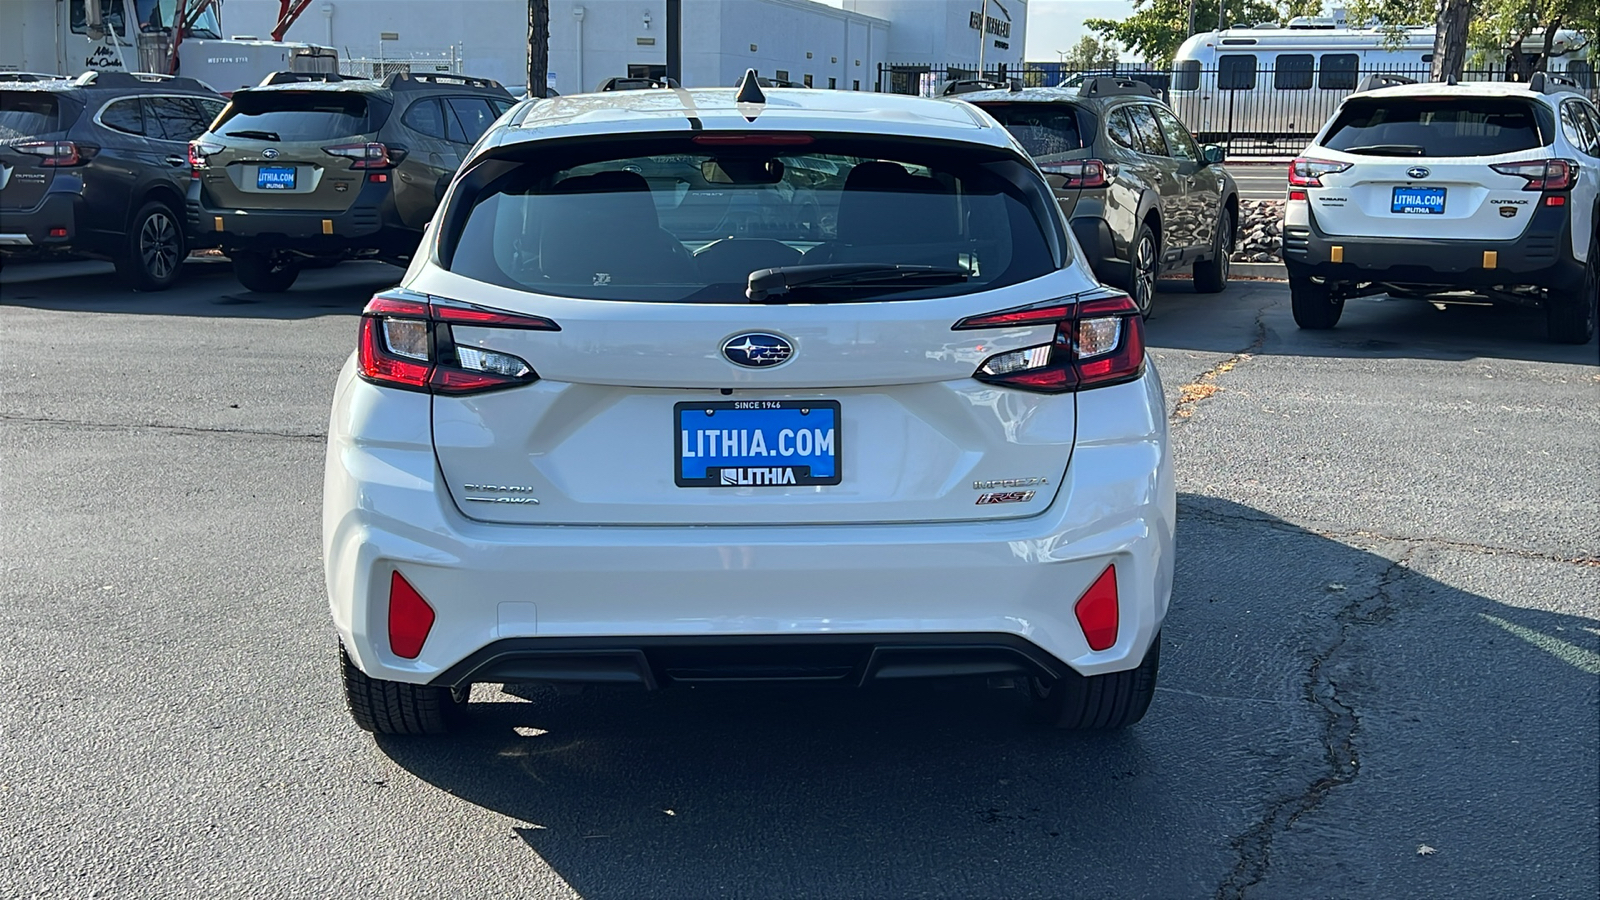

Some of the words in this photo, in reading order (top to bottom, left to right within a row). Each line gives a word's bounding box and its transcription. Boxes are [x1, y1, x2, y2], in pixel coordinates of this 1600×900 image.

[258, 173, 294, 182] LITHIA.COM
[1393, 195, 1444, 206] LITHIA.COM
[734, 401, 760, 410] SINCE
[761, 401, 782, 409] 1946
[681, 428, 835, 458] LITHIA.COM
[737, 467, 797, 485] LITHIA
[972, 477, 1050, 490] IMPREZA
